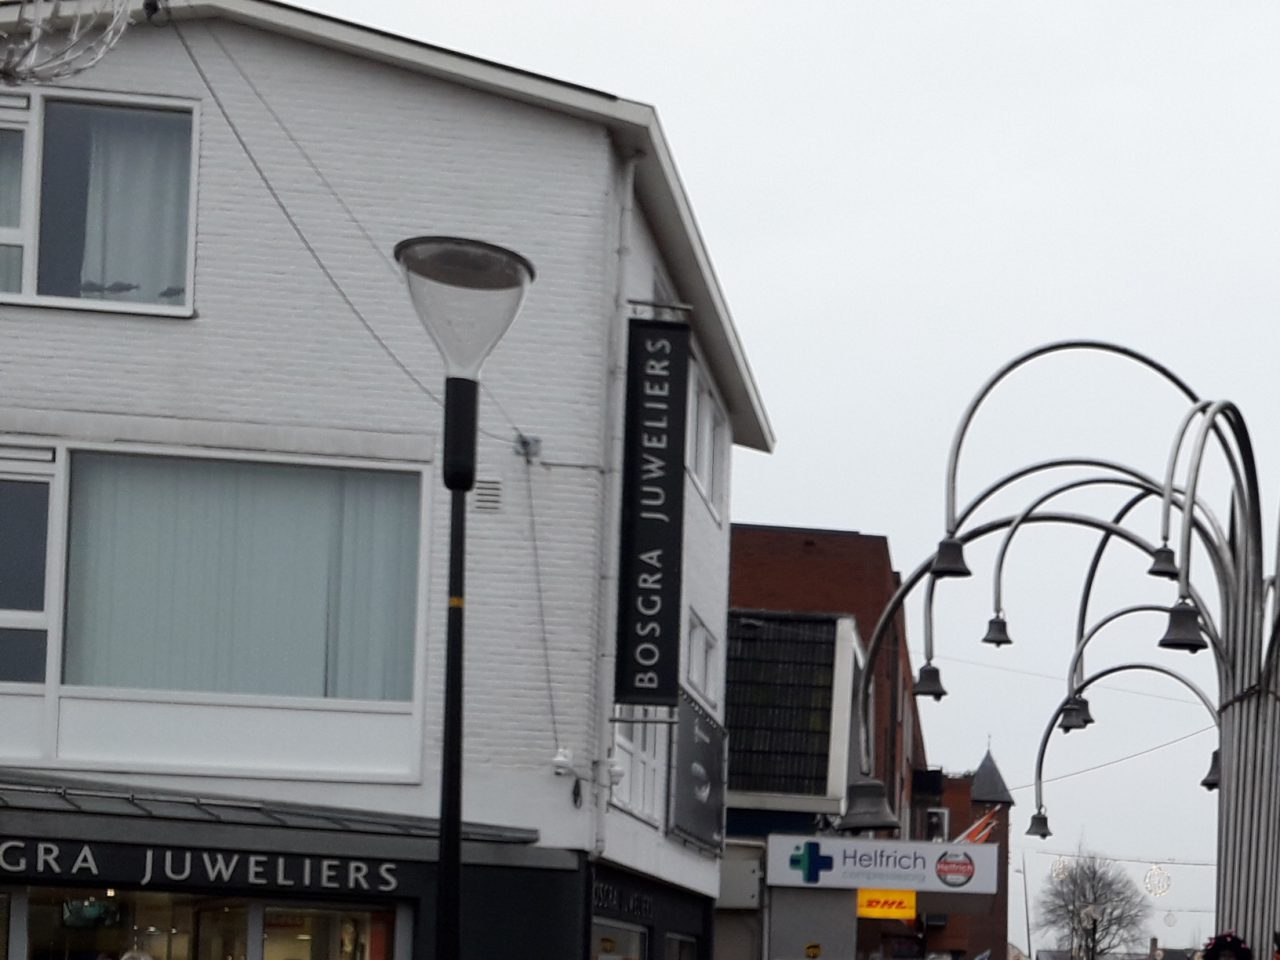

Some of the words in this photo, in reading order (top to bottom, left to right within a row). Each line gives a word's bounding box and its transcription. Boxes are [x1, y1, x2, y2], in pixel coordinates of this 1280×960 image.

[639, 337, 673, 524] JUWELIERS
[634, 548, 664, 690] BOSGRA
[0, 840, 99, 875] GRA
[139, 848, 400, 892] JUWELIERS
[842, 847, 927, 870] Helfrich
[866, 899, 908, 910] DHL
